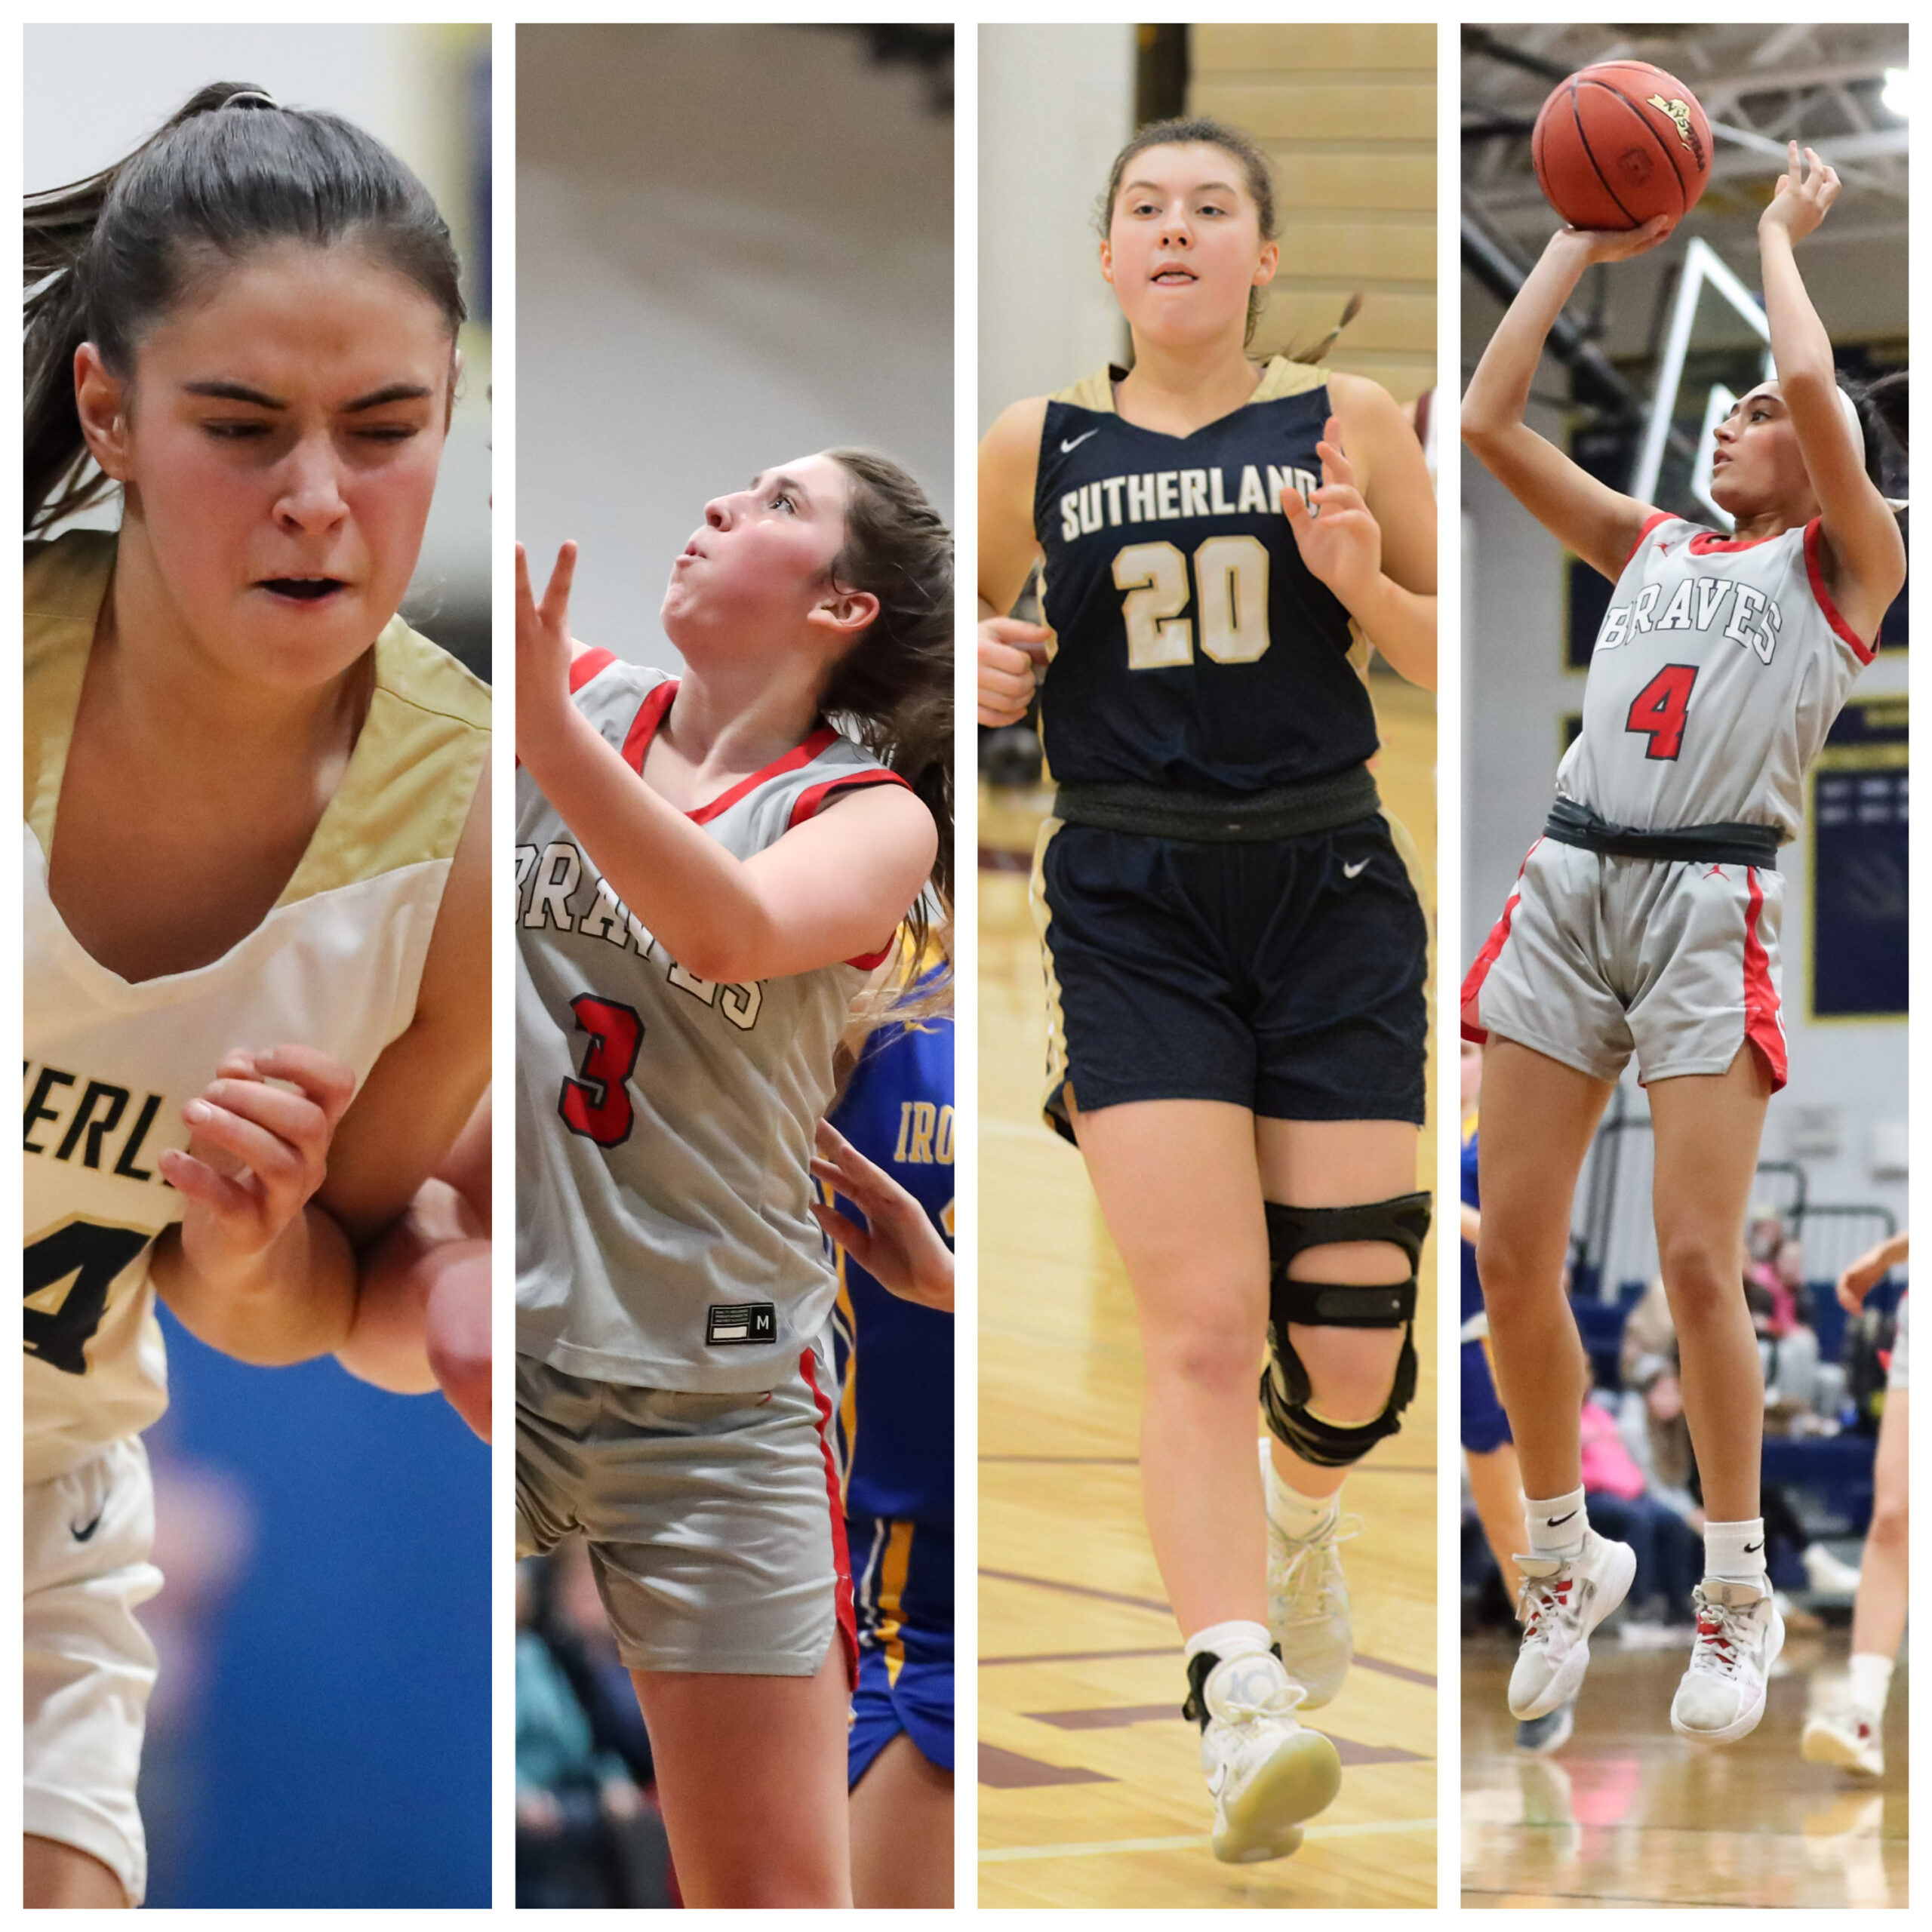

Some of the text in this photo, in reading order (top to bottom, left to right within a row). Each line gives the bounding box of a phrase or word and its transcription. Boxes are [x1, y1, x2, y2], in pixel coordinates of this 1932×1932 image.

[1060, 465, 1321, 543] SUTHERLAND
[1112, 534, 1271, 670] 20
[1594, 577, 1783, 666] BRAVES
[1625, 663, 1700, 762] 4
[558, 992, 645, 1149] 3
[23, 1060, 177, 1190] ERL
[757, 1315, 769, 1330] M
